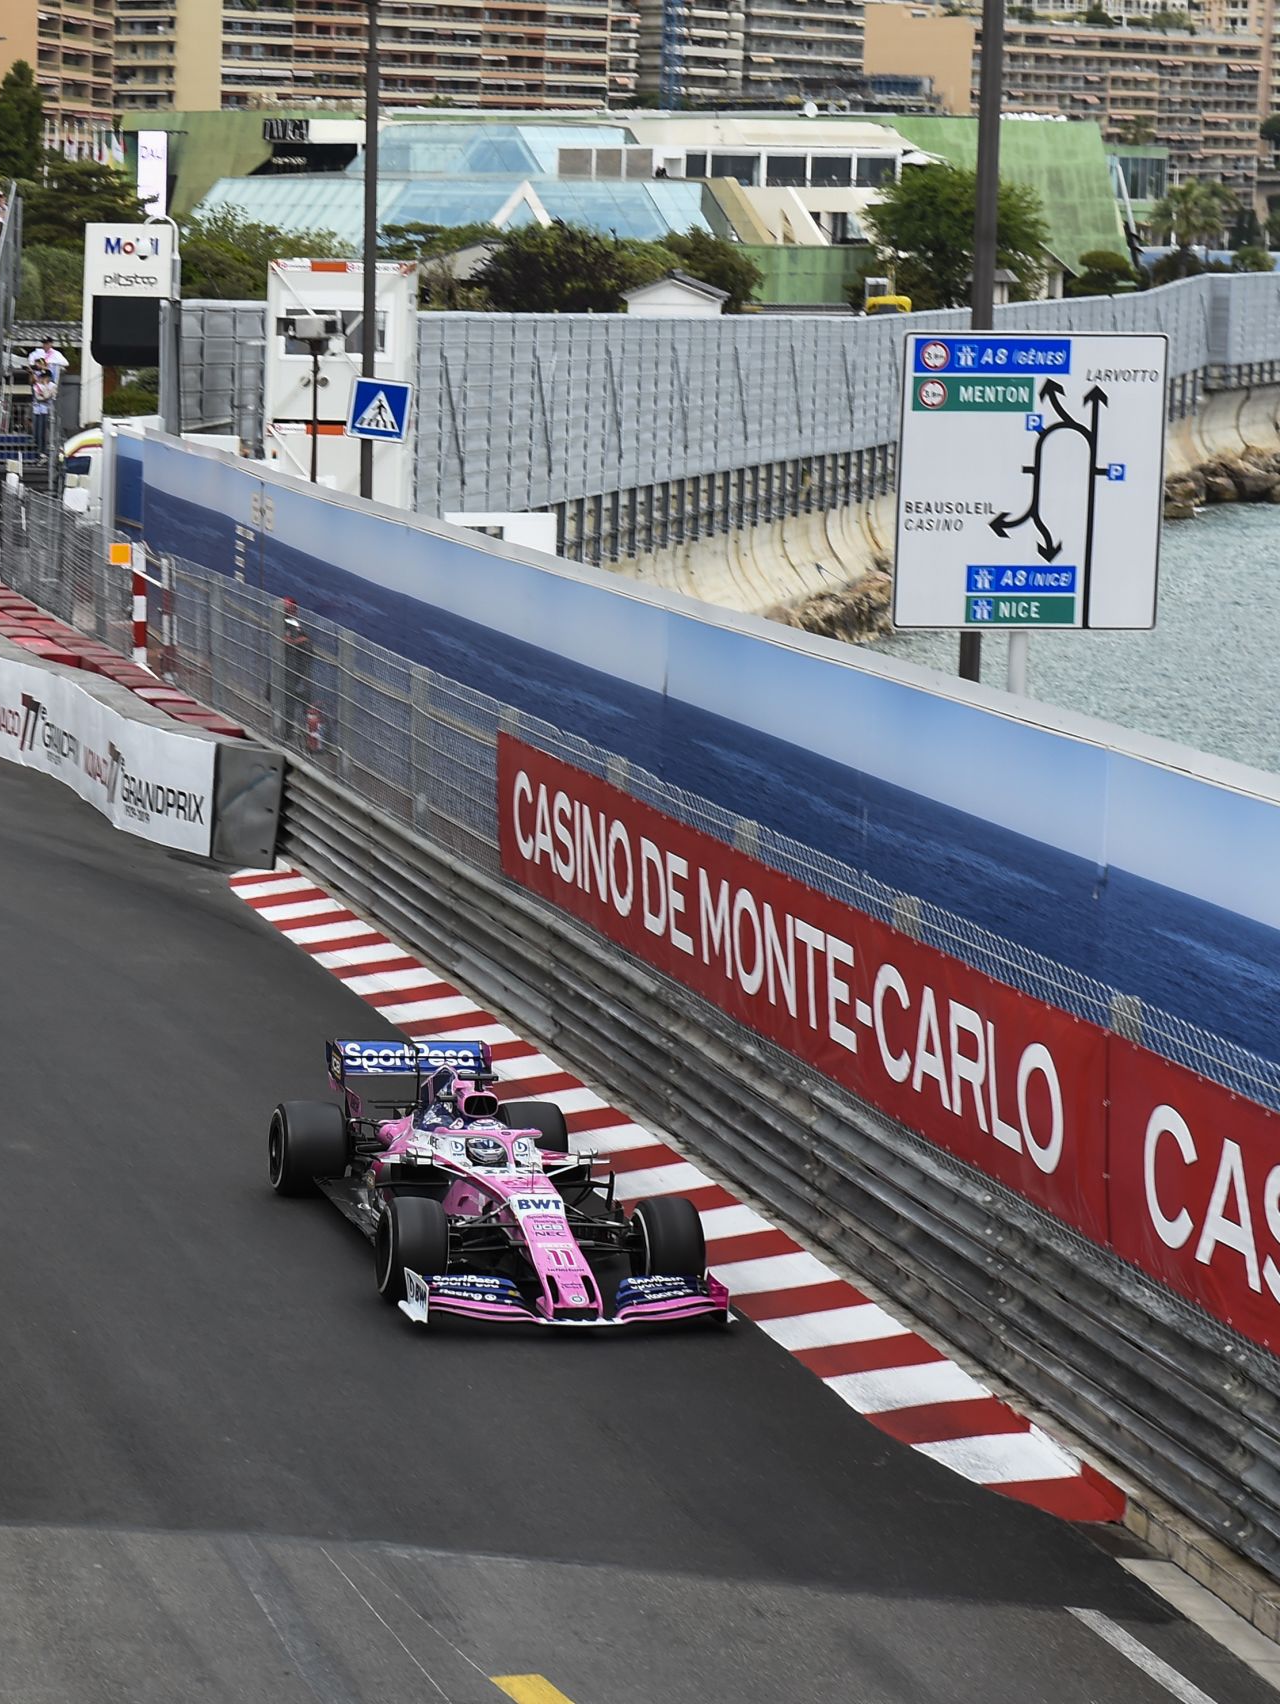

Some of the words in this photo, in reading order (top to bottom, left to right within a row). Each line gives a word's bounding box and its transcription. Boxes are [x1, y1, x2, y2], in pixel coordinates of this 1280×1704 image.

[104, 237, 159, 256] Moil
[1086, 369, 1160, 383] LARVOTTO
[959, 385, 1030, 403] MENTON
[1028, 415, 1041, 430] P
[1110, 465, 1123, 480] P
[904, 501, 997, 515] BEAUSOLEIL
[904, 518, 964, 532] CASINO
[998, 602, 1041, 618] NICE
[121, 774, 205, 826] GRANDPRIX
[513, 770, 633, 917] CASINO
[640, 836, 695, 956] DE
[698, 866, 1064, 1175] MONTE-CARLO
[517, 1199, 562, 1210] BWT
[546, 1249, 577, 1268] 11
